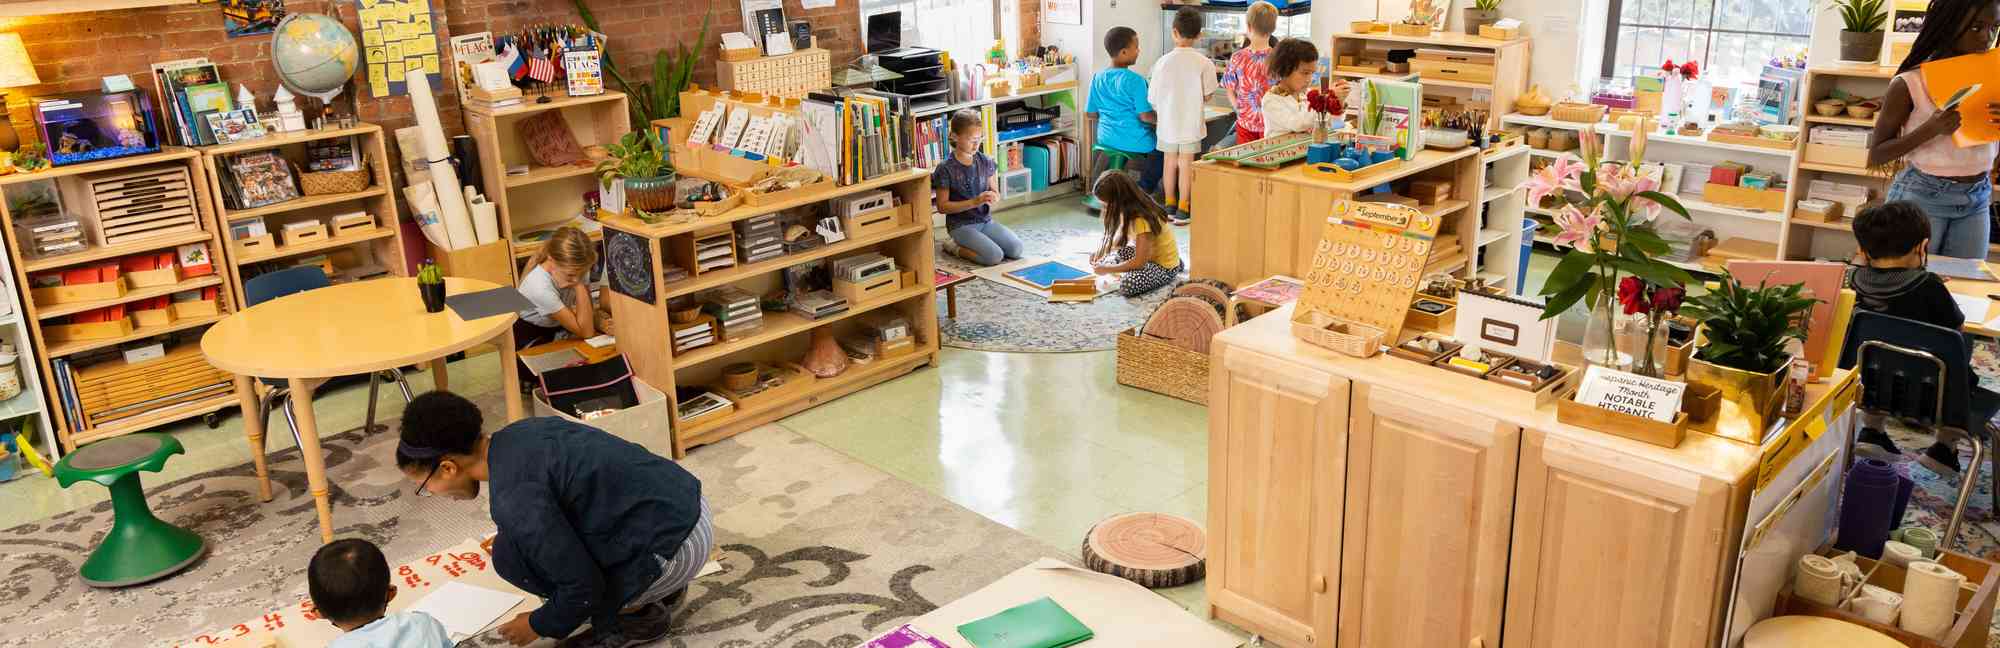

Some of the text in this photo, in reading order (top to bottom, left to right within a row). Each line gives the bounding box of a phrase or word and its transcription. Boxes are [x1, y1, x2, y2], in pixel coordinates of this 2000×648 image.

[1360, 208, 1398, 222] September
[1600, 374, 1679, 397] spanic Heritage
[1617, 385, 1650, 400] Month
[1604, 392, 1656, 410] NOTABLE
[232, 624, 249, 637] 3
